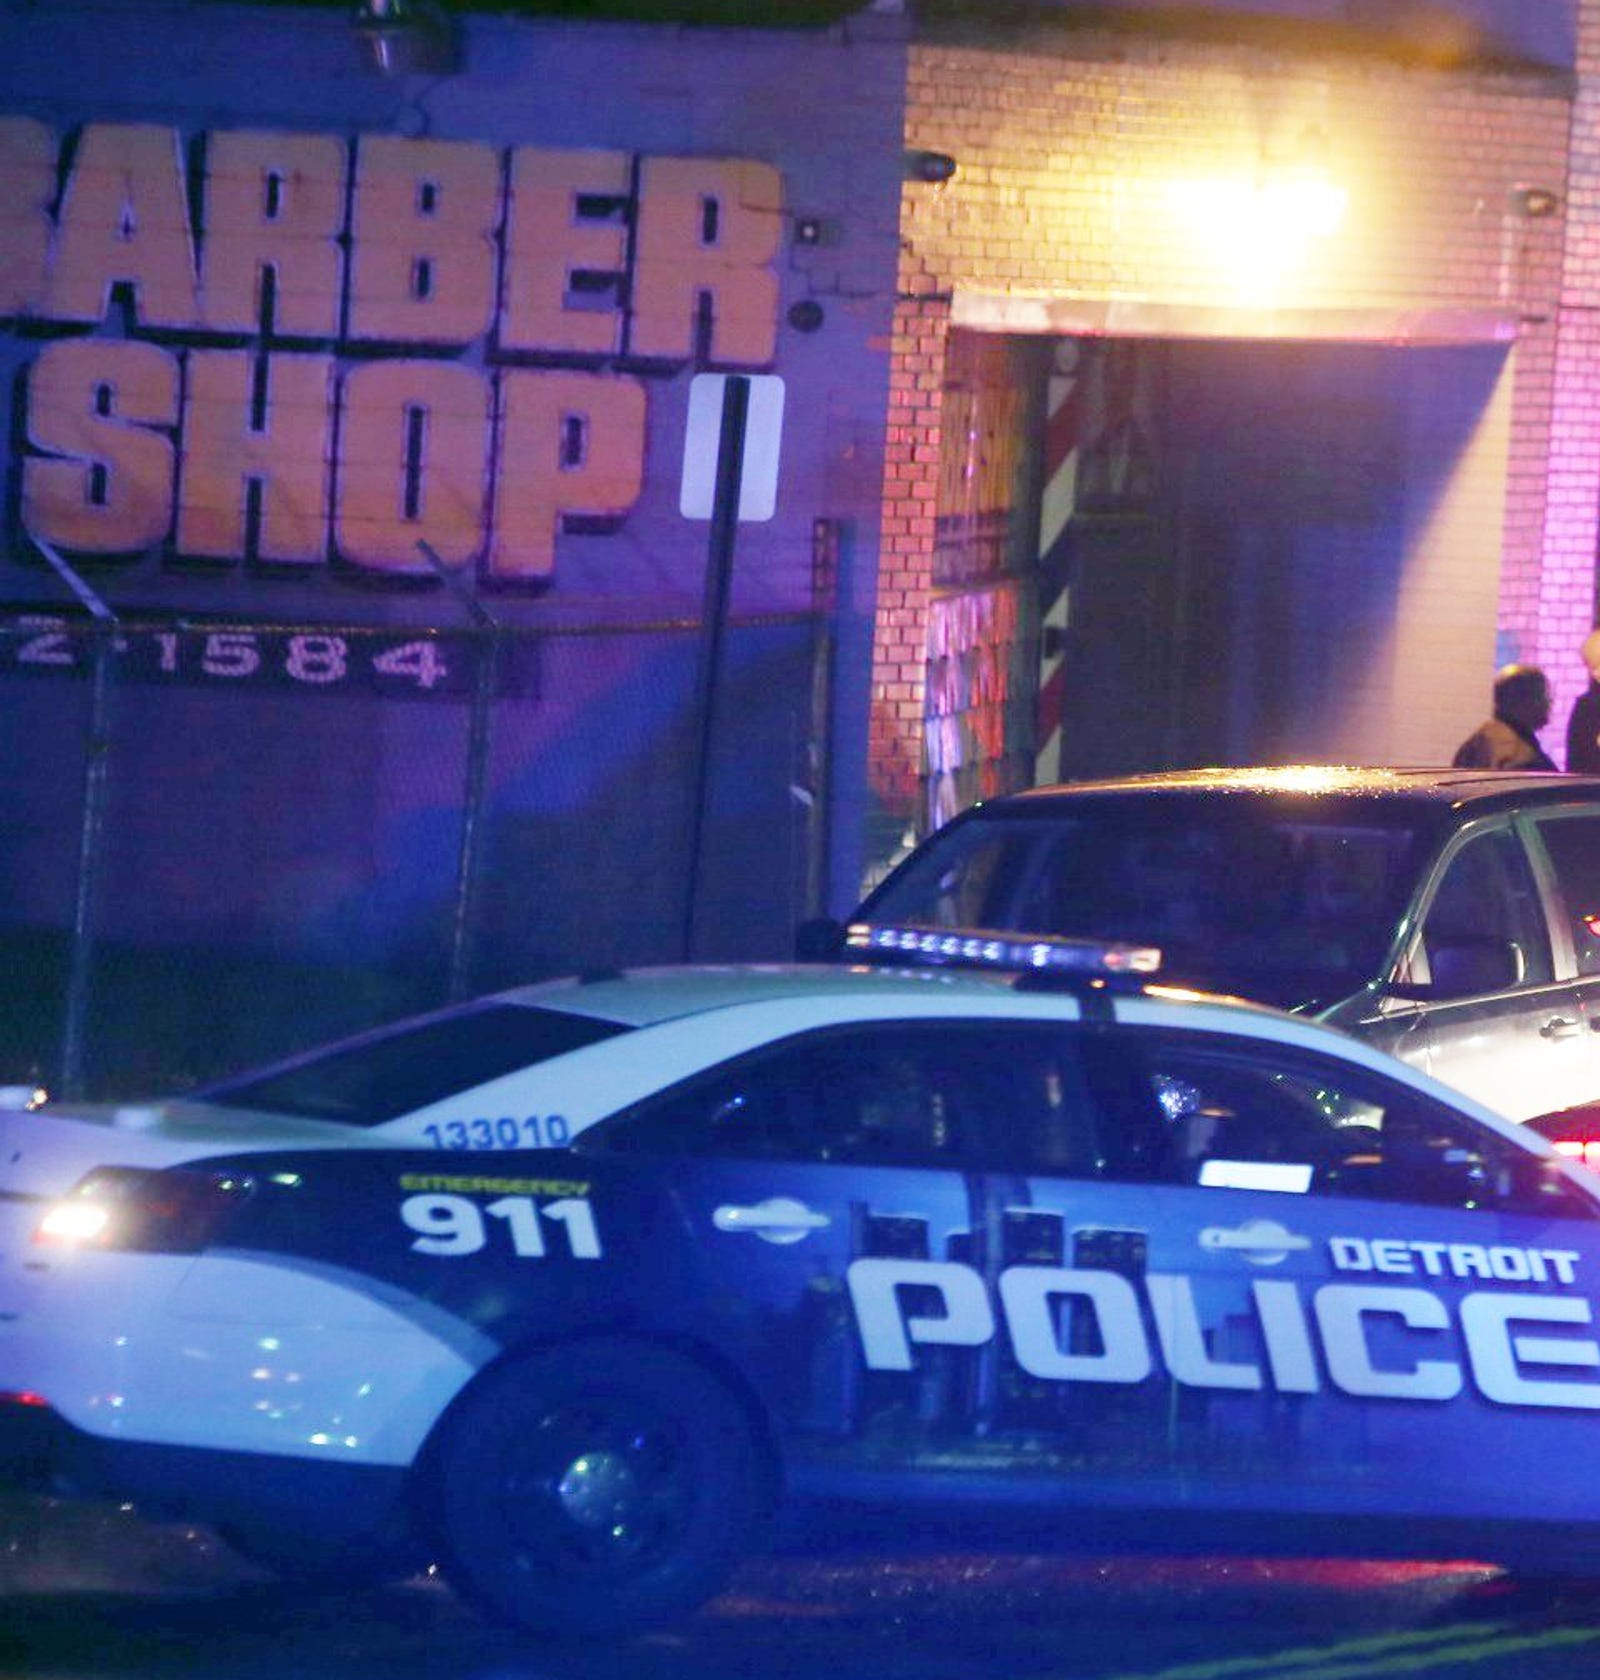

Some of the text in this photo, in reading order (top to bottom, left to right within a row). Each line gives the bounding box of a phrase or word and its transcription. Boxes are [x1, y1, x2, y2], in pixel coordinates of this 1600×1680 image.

[20, 338, 647, 579] SHOP
[424, 1115, 569, 1150] 133010
[401, 1193, 602, 1259] 911
[1329, 1236, 1580, 1284] DETROIT
